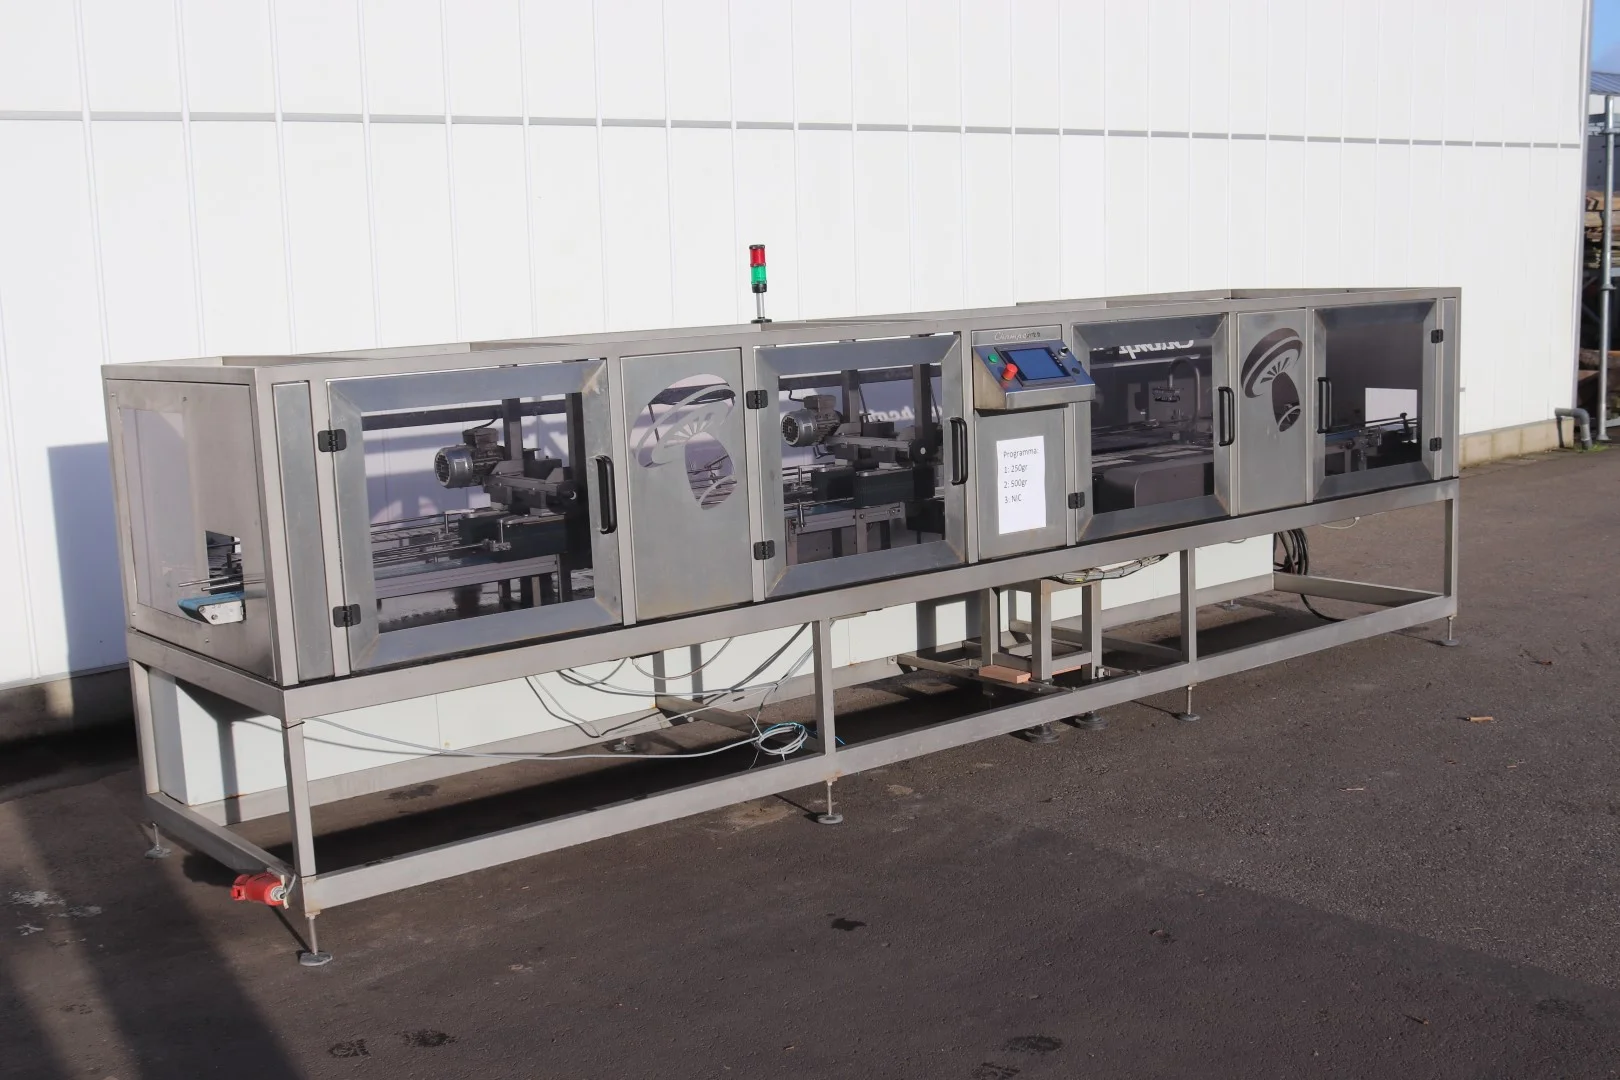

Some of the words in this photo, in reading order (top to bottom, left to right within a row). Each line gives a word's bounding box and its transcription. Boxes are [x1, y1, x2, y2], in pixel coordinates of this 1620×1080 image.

[1003, 447, 1039, 459] Programma:
[1011, 464, 1028, 473] 250gr
[1003, 481, 1010, 489] 2:
[1011, 479, 1028, 488] 500gr
